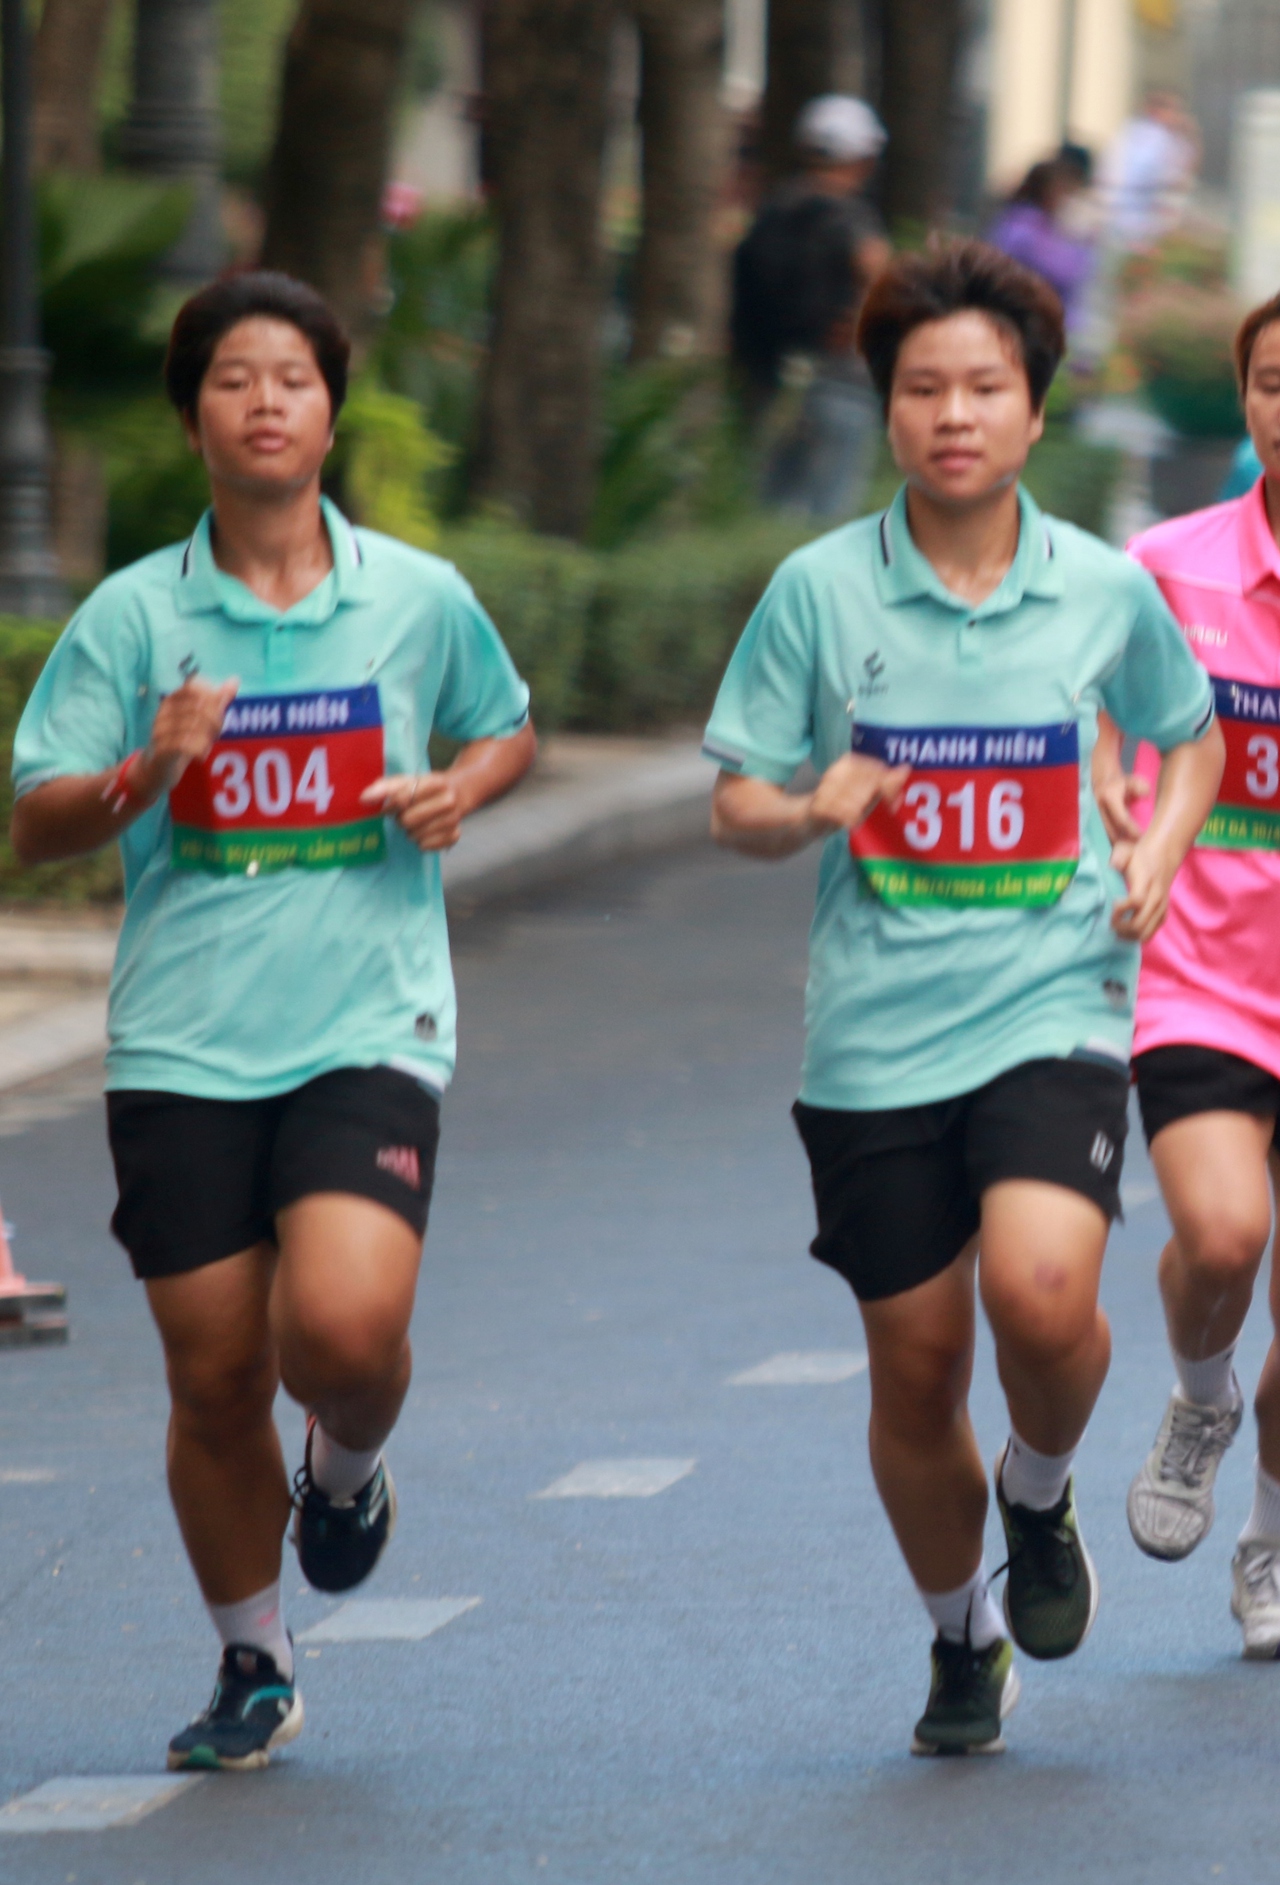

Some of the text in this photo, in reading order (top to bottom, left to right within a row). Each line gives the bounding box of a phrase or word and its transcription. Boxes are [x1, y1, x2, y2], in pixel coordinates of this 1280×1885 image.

[221, 694, 349, 734] ANH NIÊN
[886, 731, 1046, 763] THANH NIÊN
[211, 747, 334, 818] 304
[904, 779, 1024, 851] 316
